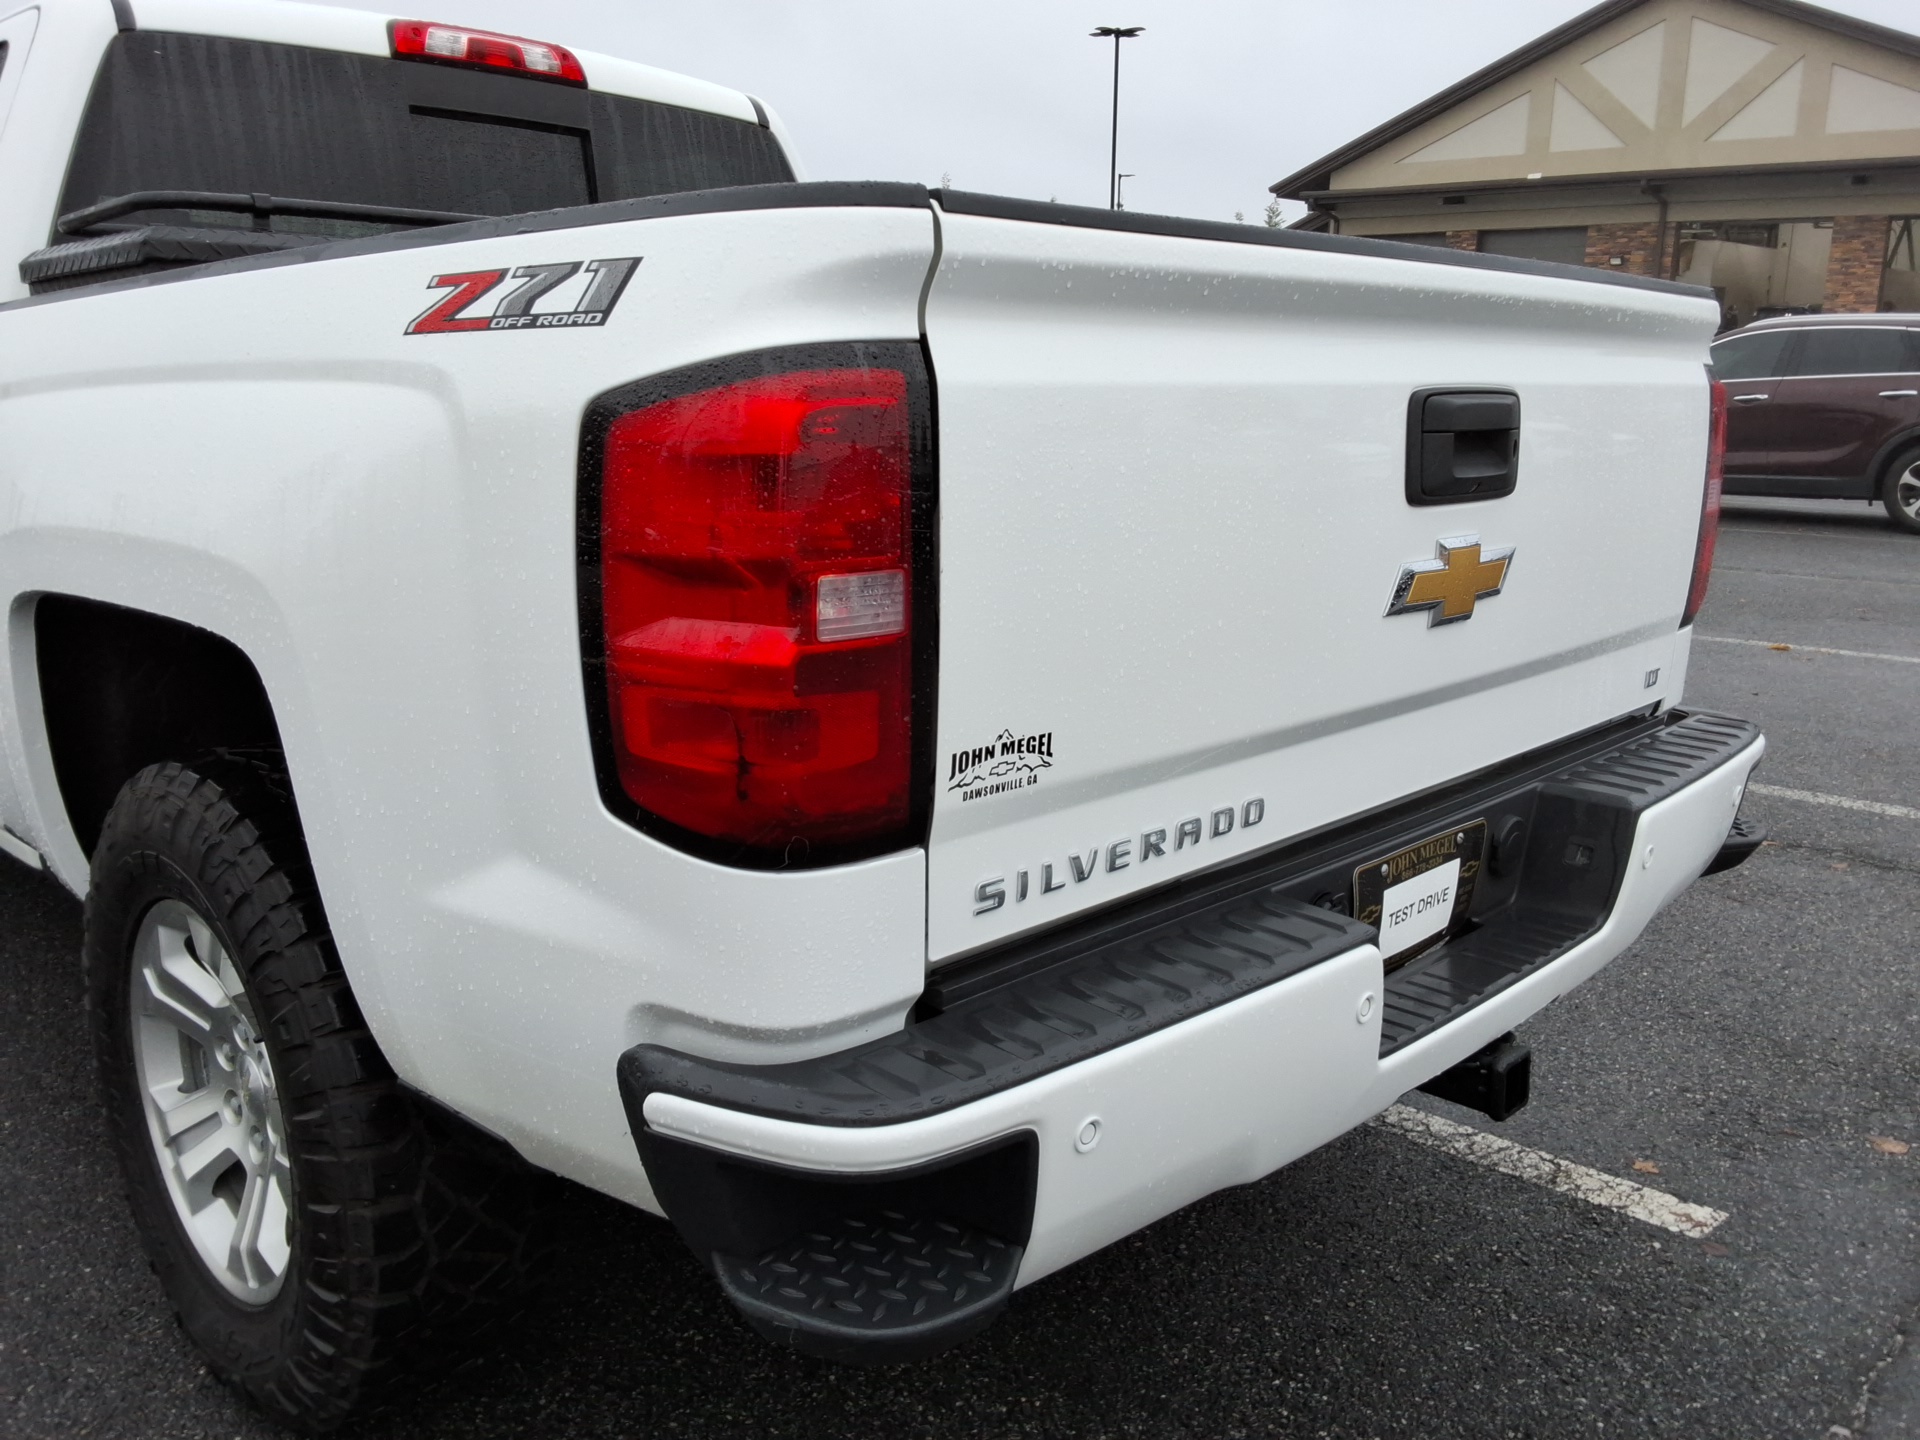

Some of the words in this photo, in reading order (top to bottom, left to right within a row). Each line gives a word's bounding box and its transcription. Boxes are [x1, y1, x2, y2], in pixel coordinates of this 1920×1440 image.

[403, 256, 644, 335] Z71
[490, 315, 531, 329] OFF
[536, 312, 603, 326] ROAD
[949, 744, 996, 782] JOHN
[1000, 732, 1053, 758] MEGEL
[962, 777, 1025, 802] DAWSONVILLE,
[1027, 774, 1038, 786] GA
[972, 796, 1265, 917] SILVERADO
[1387, 848, 1418, 884] JOHN
[1419, 834, 1457, 861] MEGEL
[1388, 902, 1416, 928] TEST
[1417, 886, 1450, 915] DRIVE
